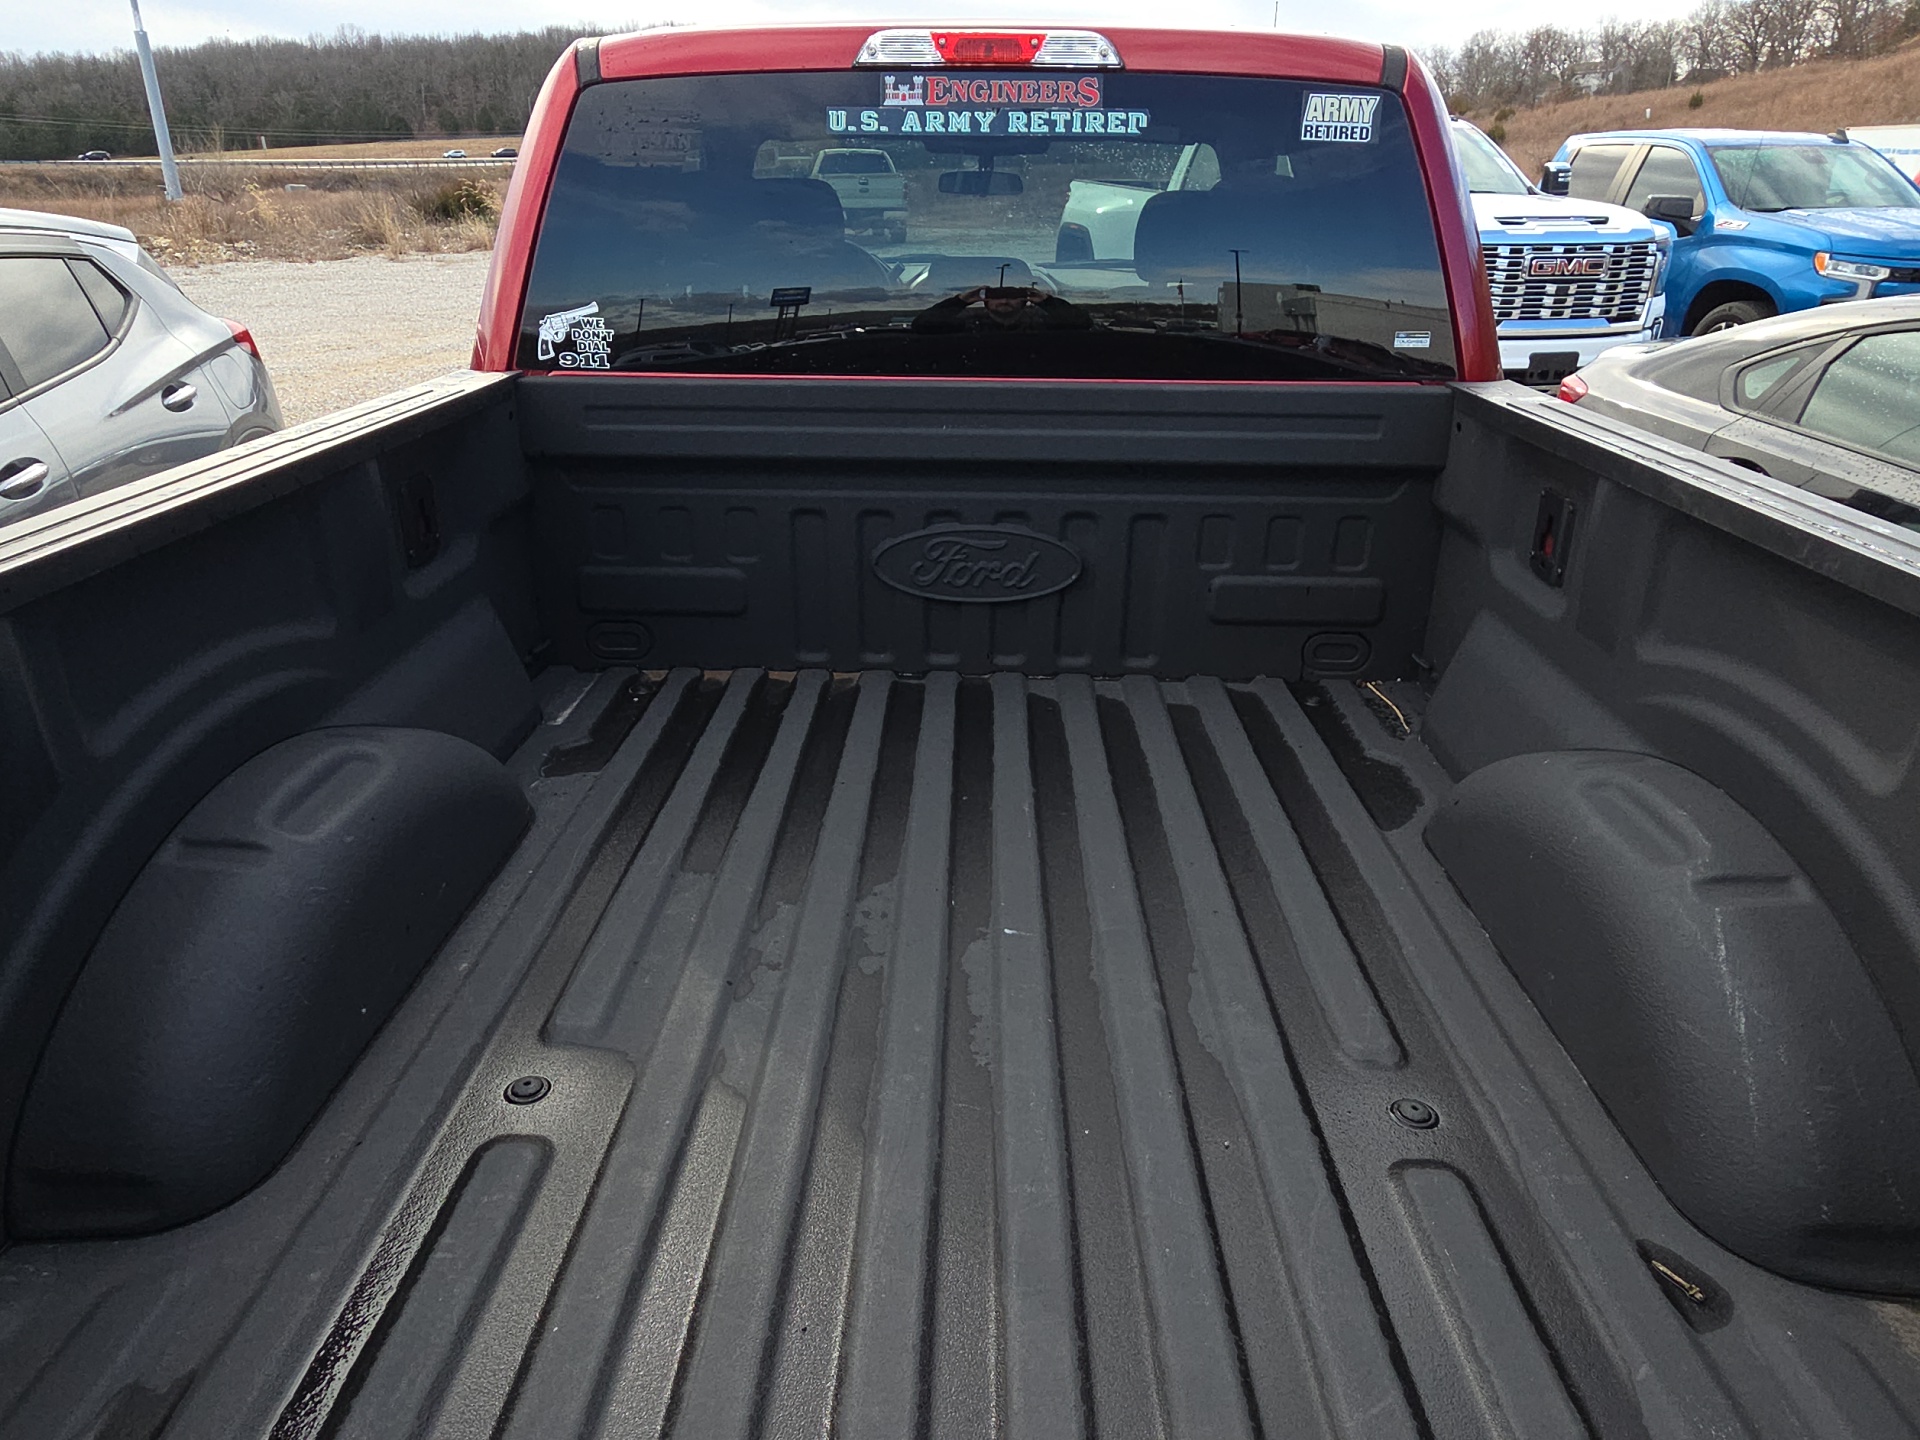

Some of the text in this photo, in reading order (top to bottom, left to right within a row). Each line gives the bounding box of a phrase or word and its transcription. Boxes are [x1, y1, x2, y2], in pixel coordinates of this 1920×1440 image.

[925, 76, 1100, 107] ENGINEERS
[1306, 96, 1377, 124] ARMY
[828, 110, 889, 132] U.S.
[901, 110, 996, 132] ARMY
[1303, 124, 1370, 140] RETIRED
[1531, 258, 1605, 275] GMC
[580, 317, 605, 329] WE
[571, 329, 614, 341] DON'T
[577, 341, 611, 353] DIAL
[559, 352, 610, 369] 911
[910, 536, 1041, 588] Ford
